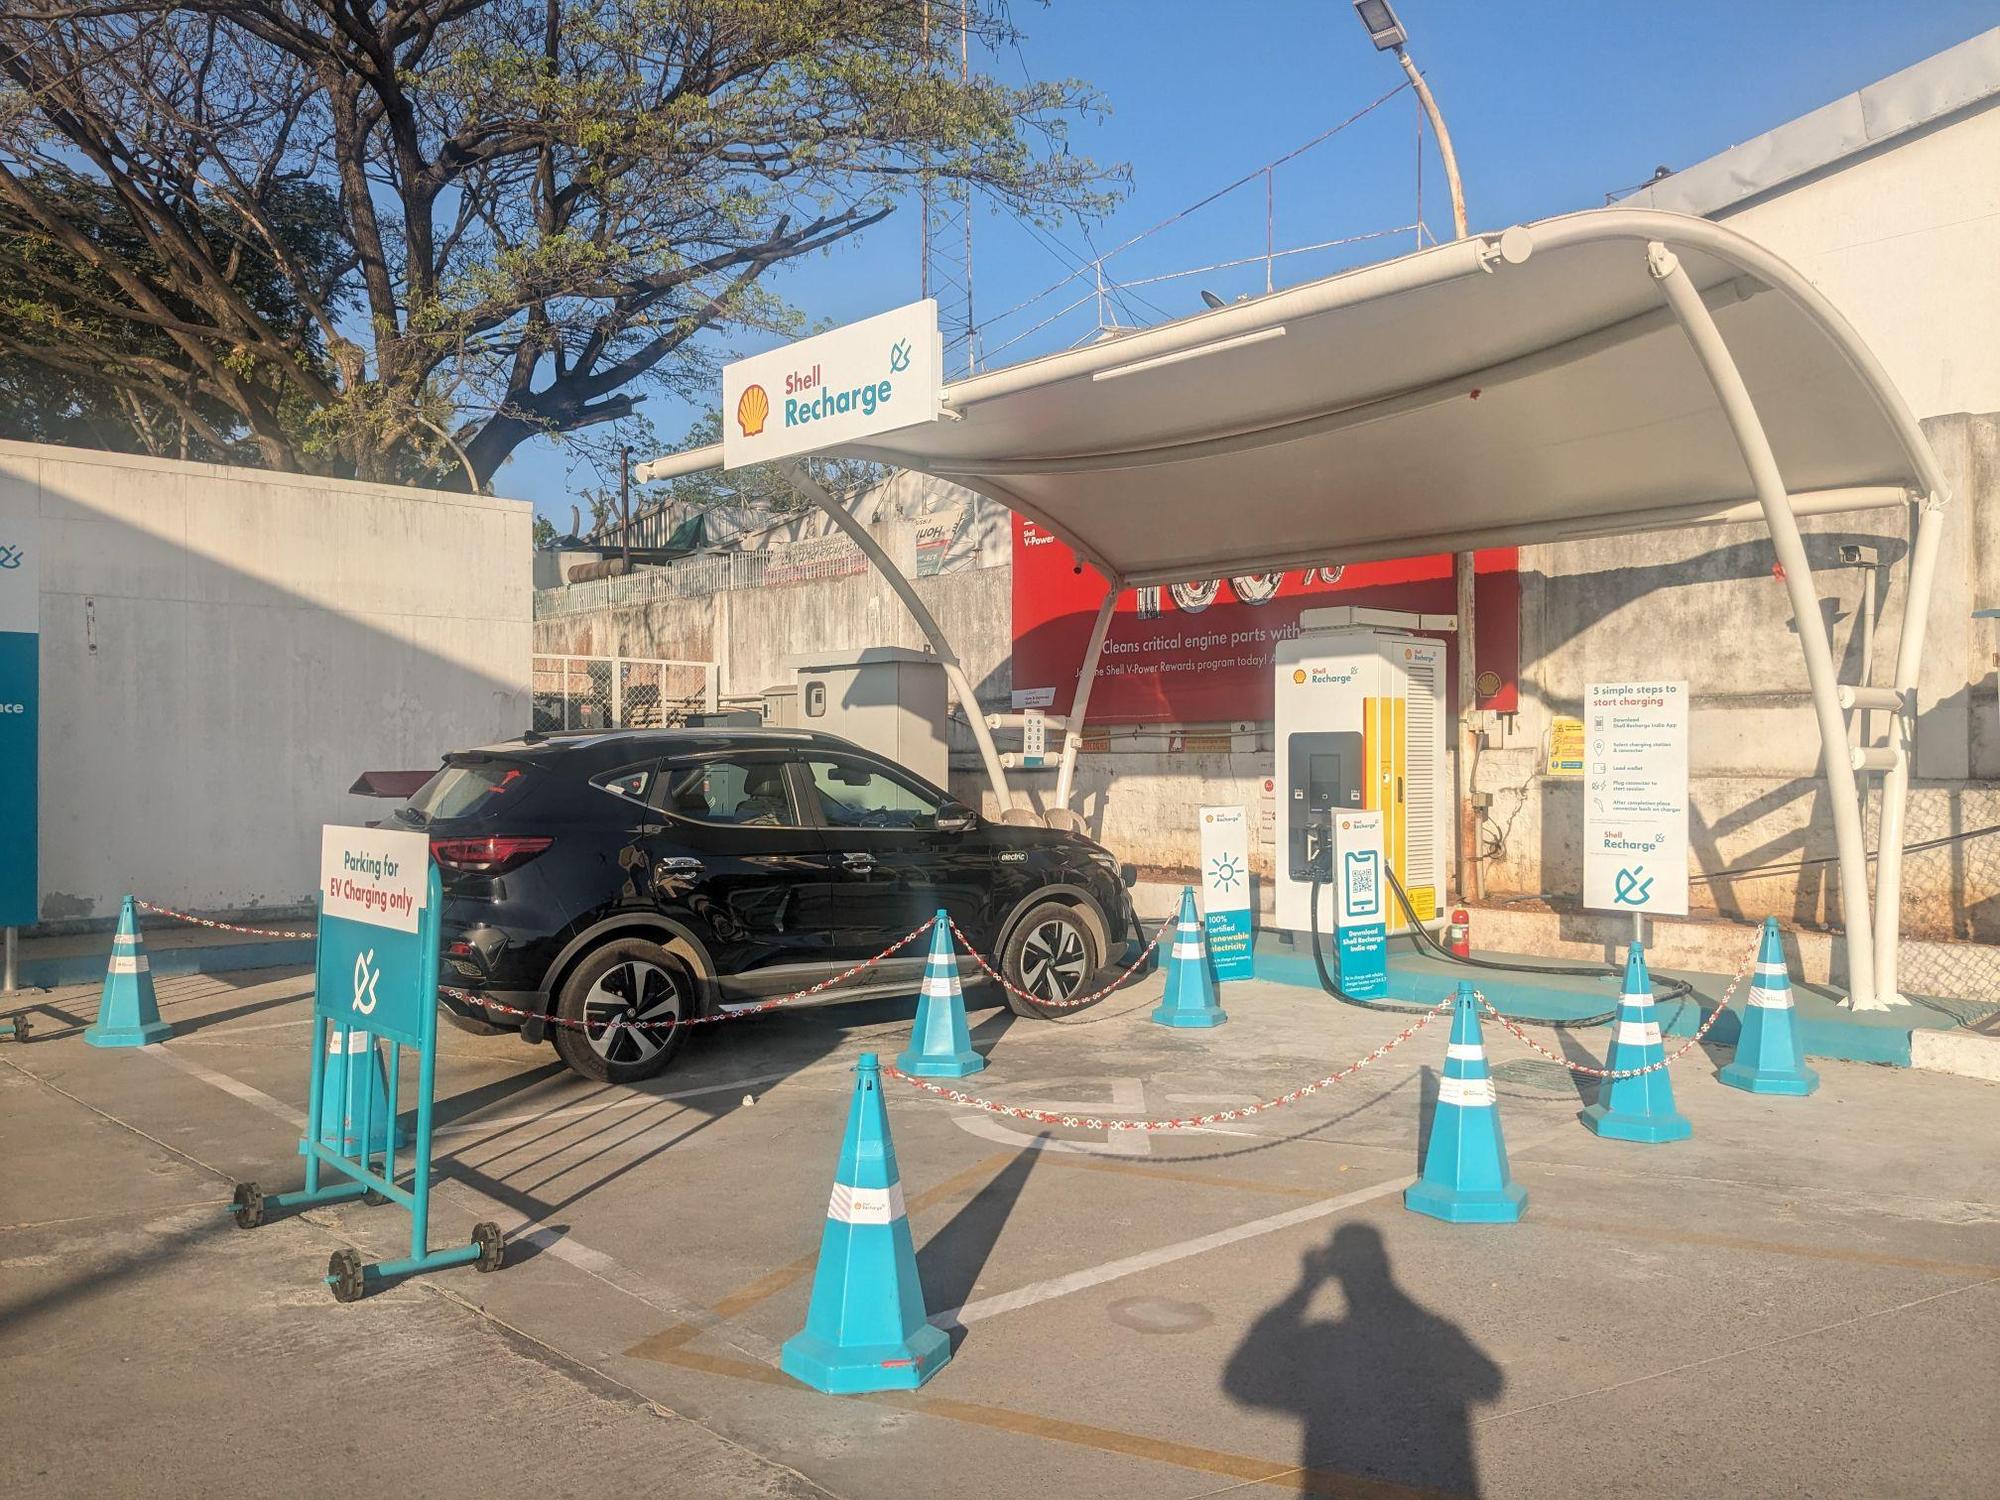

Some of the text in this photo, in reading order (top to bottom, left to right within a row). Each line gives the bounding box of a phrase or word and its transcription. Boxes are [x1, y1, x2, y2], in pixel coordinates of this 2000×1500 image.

[785, 363, 821, 395] Shell
[784, 379, 892, 428] Recharge
[1023, 529, 1036, 537] Shell
[1023, 535, 1055, 546] V-Power
[1102, 621, 1300, 654] Cleans critical engine parts with
[1106, 663, 1125, 675] Shell
[1126, 663, 1158, 674] V-Power
[1160, 659, 1195, 672] Rewards
[1197, 658, 1235, 672] program
[1237, 653, 1267, 669] today!
[1312, 667, 1326, 675] Shell
[1311, 675, 1352, 684] Recharge
[1593, 685, 1677, 696] 5 simple steps to
[1619, 697, 1664, 707] charging
[1603, 839, 1656, 852] Recharge
[1001, 852, 1025, 861] electric
[344, 850, 399, 881] Parking for
[330, 877, 413, 917] EV Charging only
[1208, 915, 1227, 924] 100%
[1208, 923, 1235, 934] certified
[1209, 932, 1249, 943] renewable
